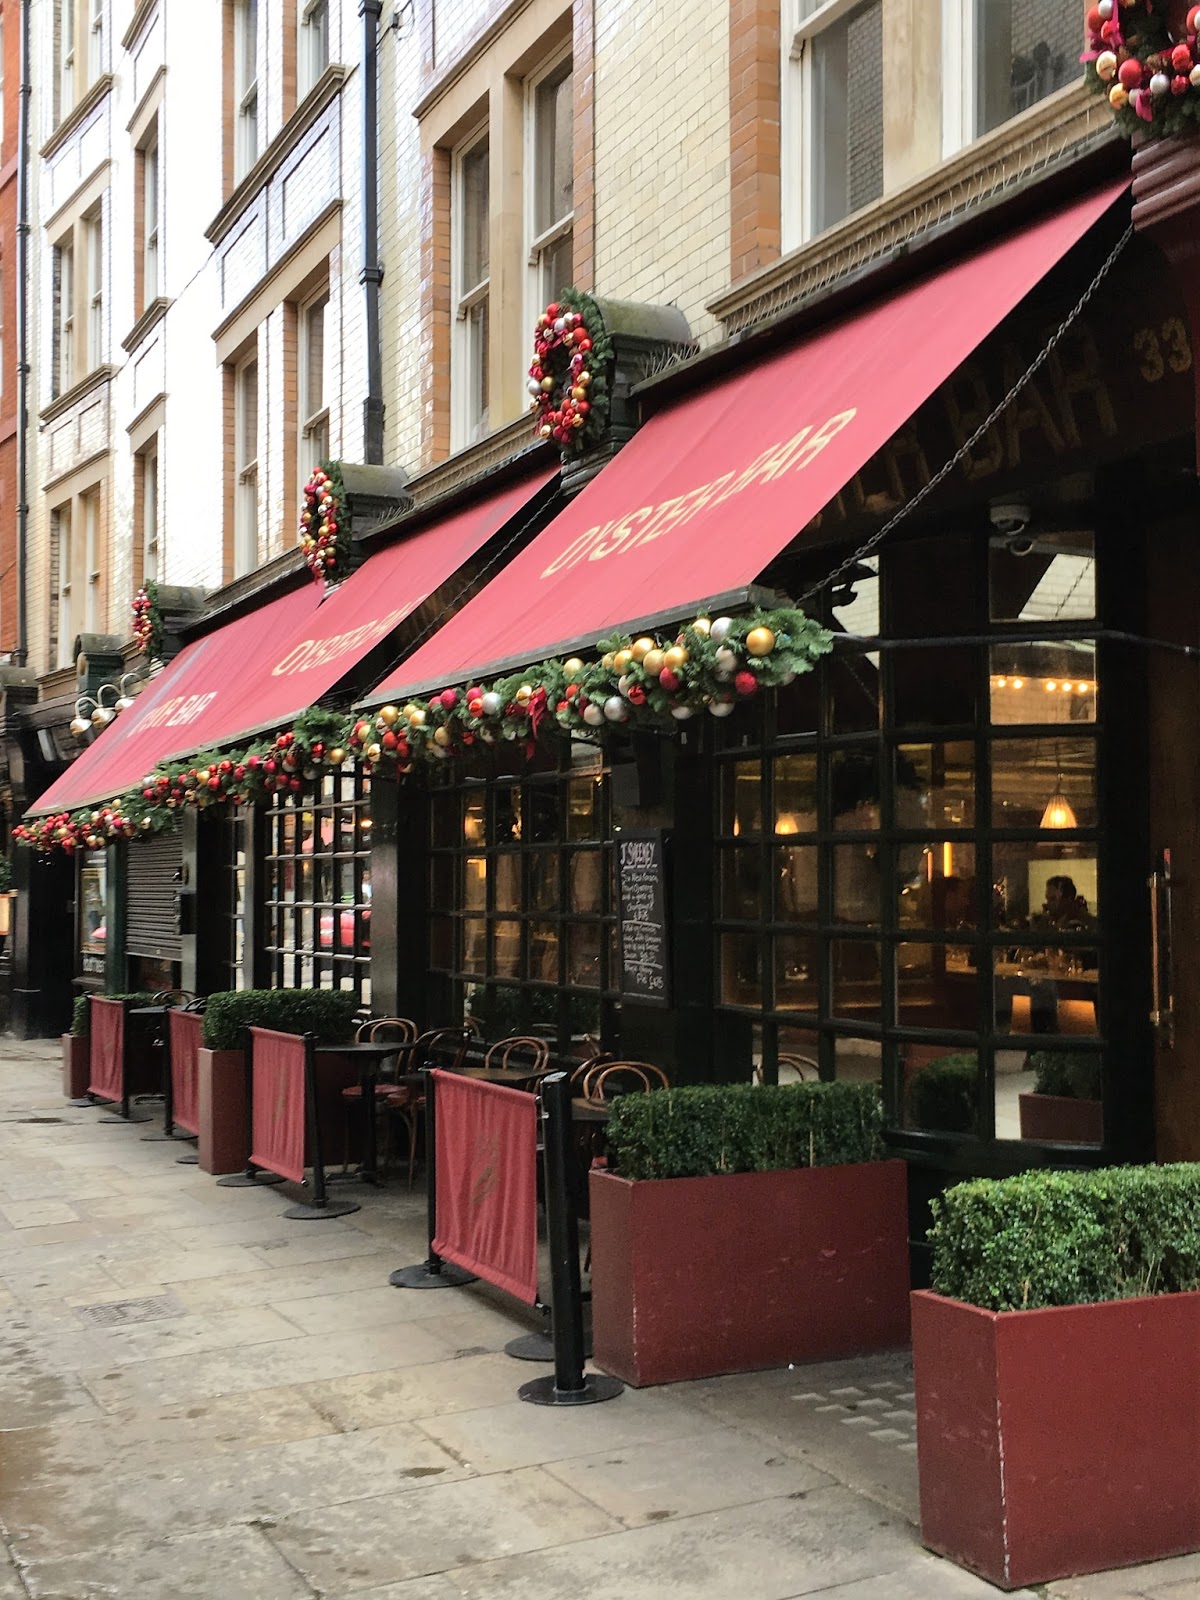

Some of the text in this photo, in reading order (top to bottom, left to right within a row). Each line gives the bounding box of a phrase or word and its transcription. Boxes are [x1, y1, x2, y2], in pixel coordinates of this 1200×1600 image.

[1132, 316, 1193, 383] 33
[540, 470, 736, 580] OYSTER
[707, 407, 857, 512] BAR
[271, 619, 378, 676] OYSTER
